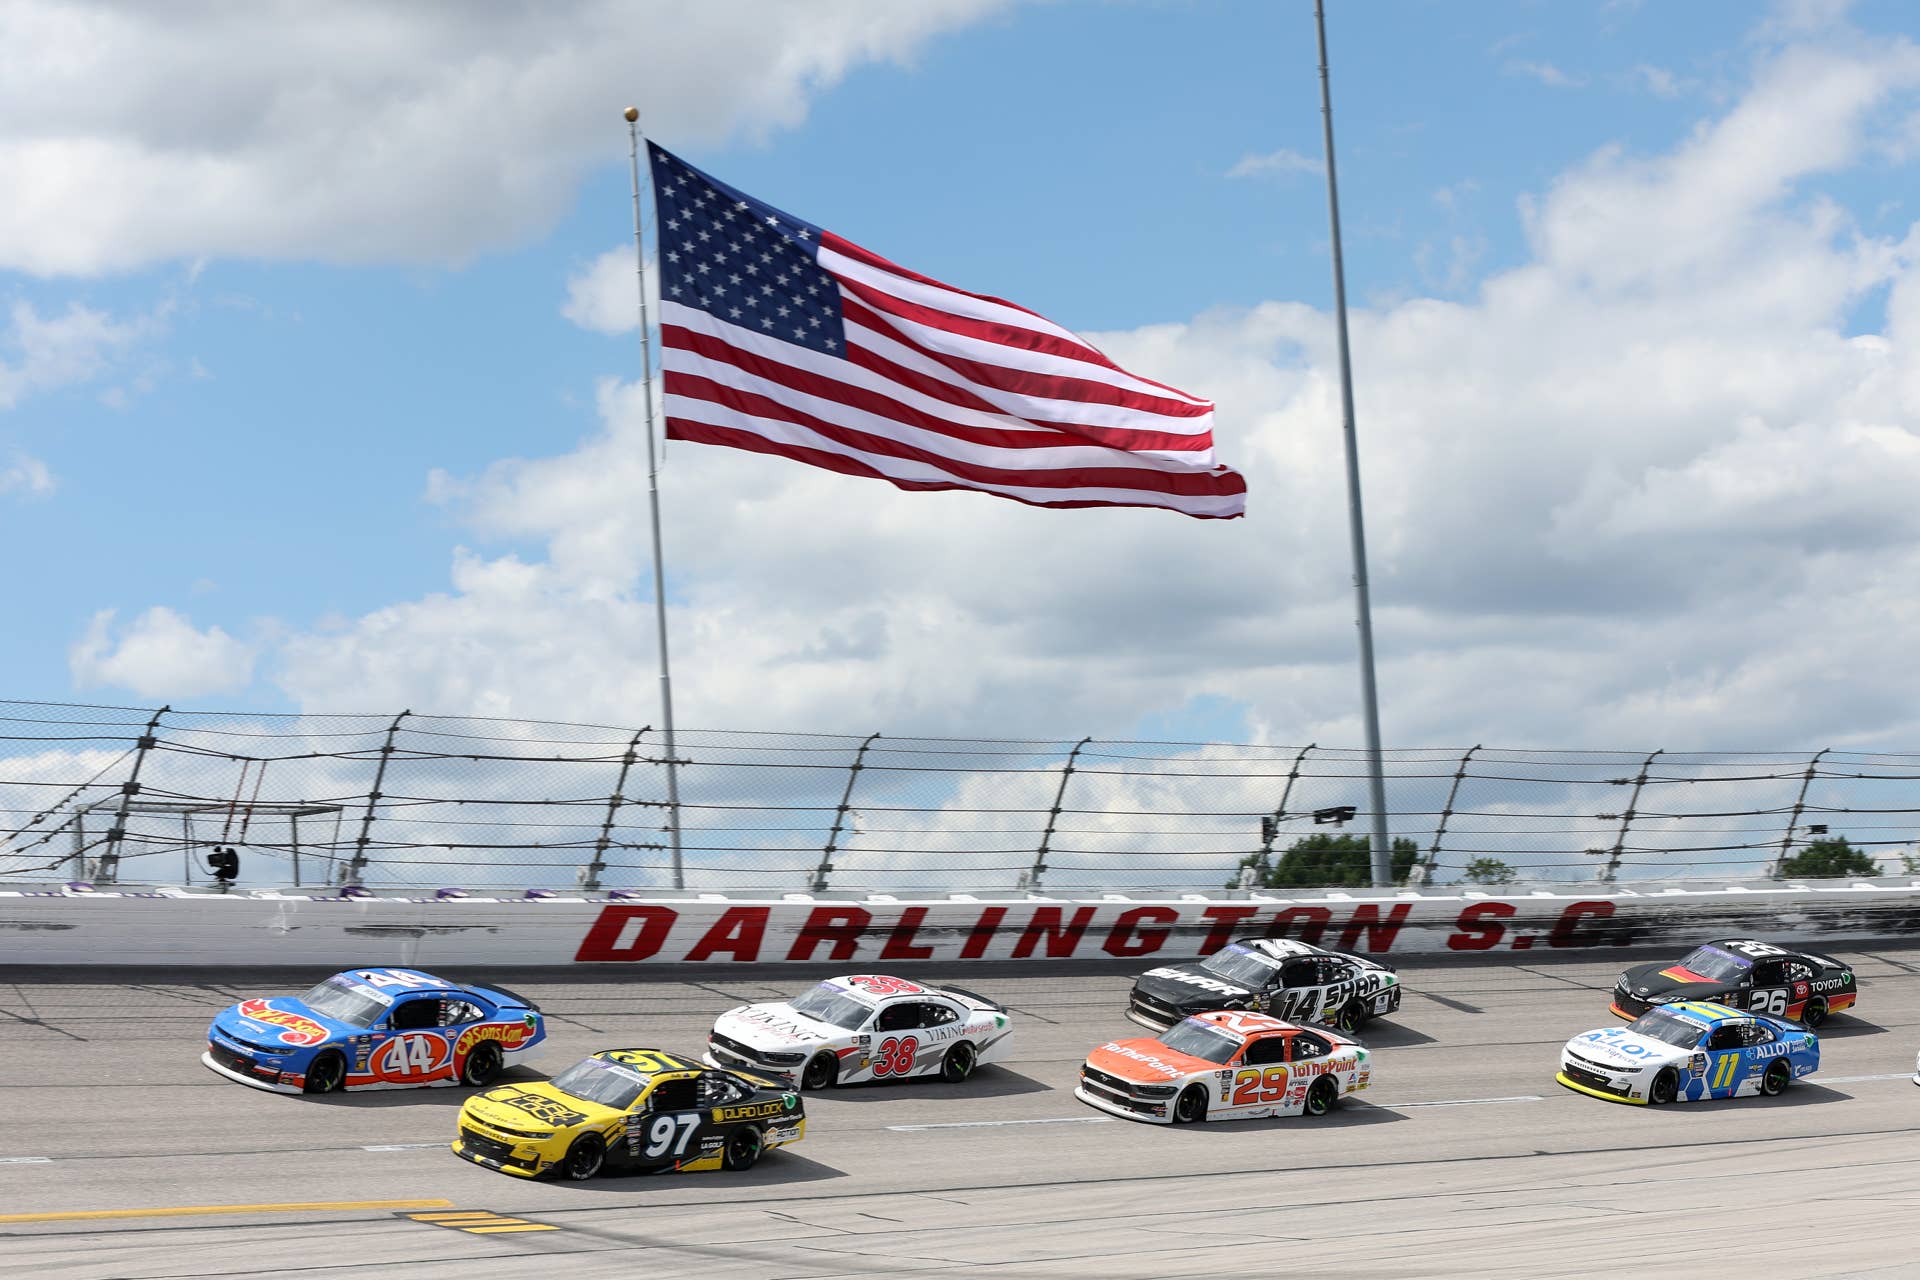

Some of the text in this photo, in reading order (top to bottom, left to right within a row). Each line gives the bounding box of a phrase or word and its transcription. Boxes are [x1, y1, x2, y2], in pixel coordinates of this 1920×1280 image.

[574, 903, 1412, 962] DARLINGTON
[1250, 938, 1313, 959] 14
[1724, 941, 1787, 957] 26
[355, 970, 451, 988] 44
[847, 976, 925, 996] 38
[1811, 978, 1843, 993] TOYOTA
[1281, 990, 1322, 1022] 14
[1751, 988, 1788, 1016] 26
[925, 1023, 965, 1041] VIKING
[388, 1034, 435, 1075] 44
[872, 1034, 919, 1078] 38
[1580, 1032, 1663, 1060] ALLOY
[1756, 1041, 1791, 1059] ALLOY
[606, 1050, 687, 1074] 97
[1101, 1042, 1185, 1079] ToThePoint
[1289, 1057, 1357, 1078] ToThePoint
[1713, 1053, 1740, 1089] 11
[1232, 1066, 1289, 1106] 29
[724, 1103, 783, 1119] QUAD LOCK
[645, 1113, 701, 1157] 97
